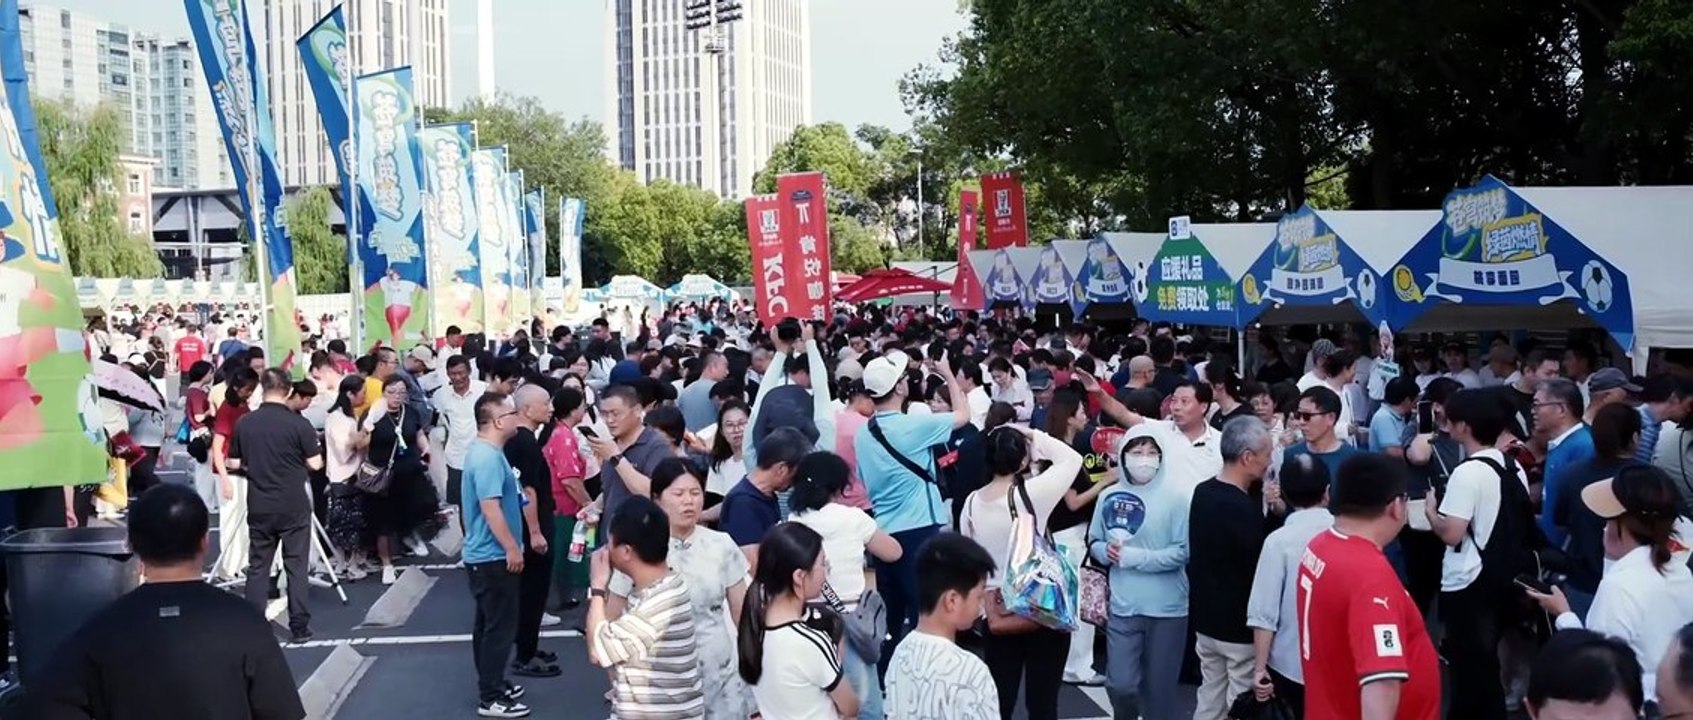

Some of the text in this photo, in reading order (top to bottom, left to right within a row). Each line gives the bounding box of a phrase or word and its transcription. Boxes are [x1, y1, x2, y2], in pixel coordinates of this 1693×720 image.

[1161, 255, 1203, 280] 应援礼品
[1157, 285, 1210, 311] 免费领取处
[1300, 573, 1313, 661] 7
